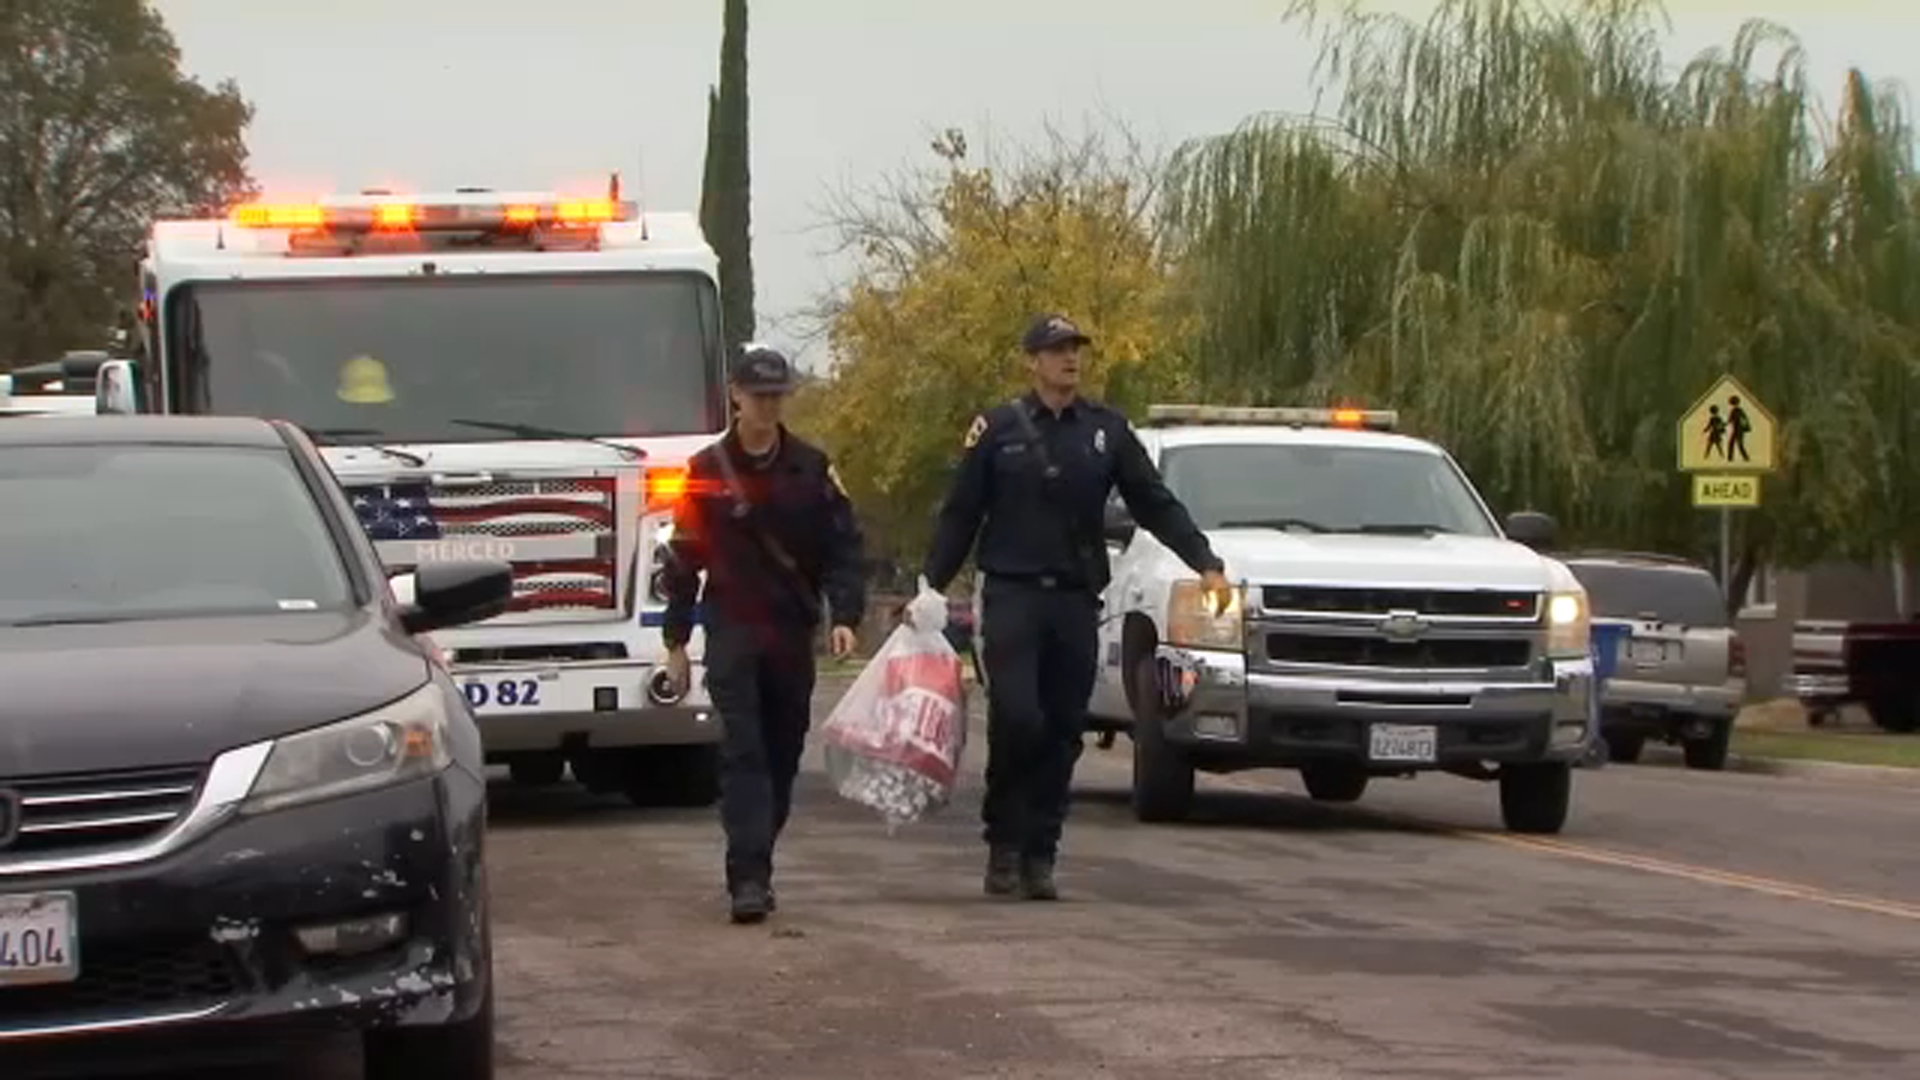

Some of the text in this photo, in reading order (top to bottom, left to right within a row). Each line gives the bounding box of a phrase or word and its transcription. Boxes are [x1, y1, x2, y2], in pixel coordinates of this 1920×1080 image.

[1702, 482, 1753, 499] AHEAD
[416, 541, 515, 561] MERCED
[496, 680, 540, 706] 82
